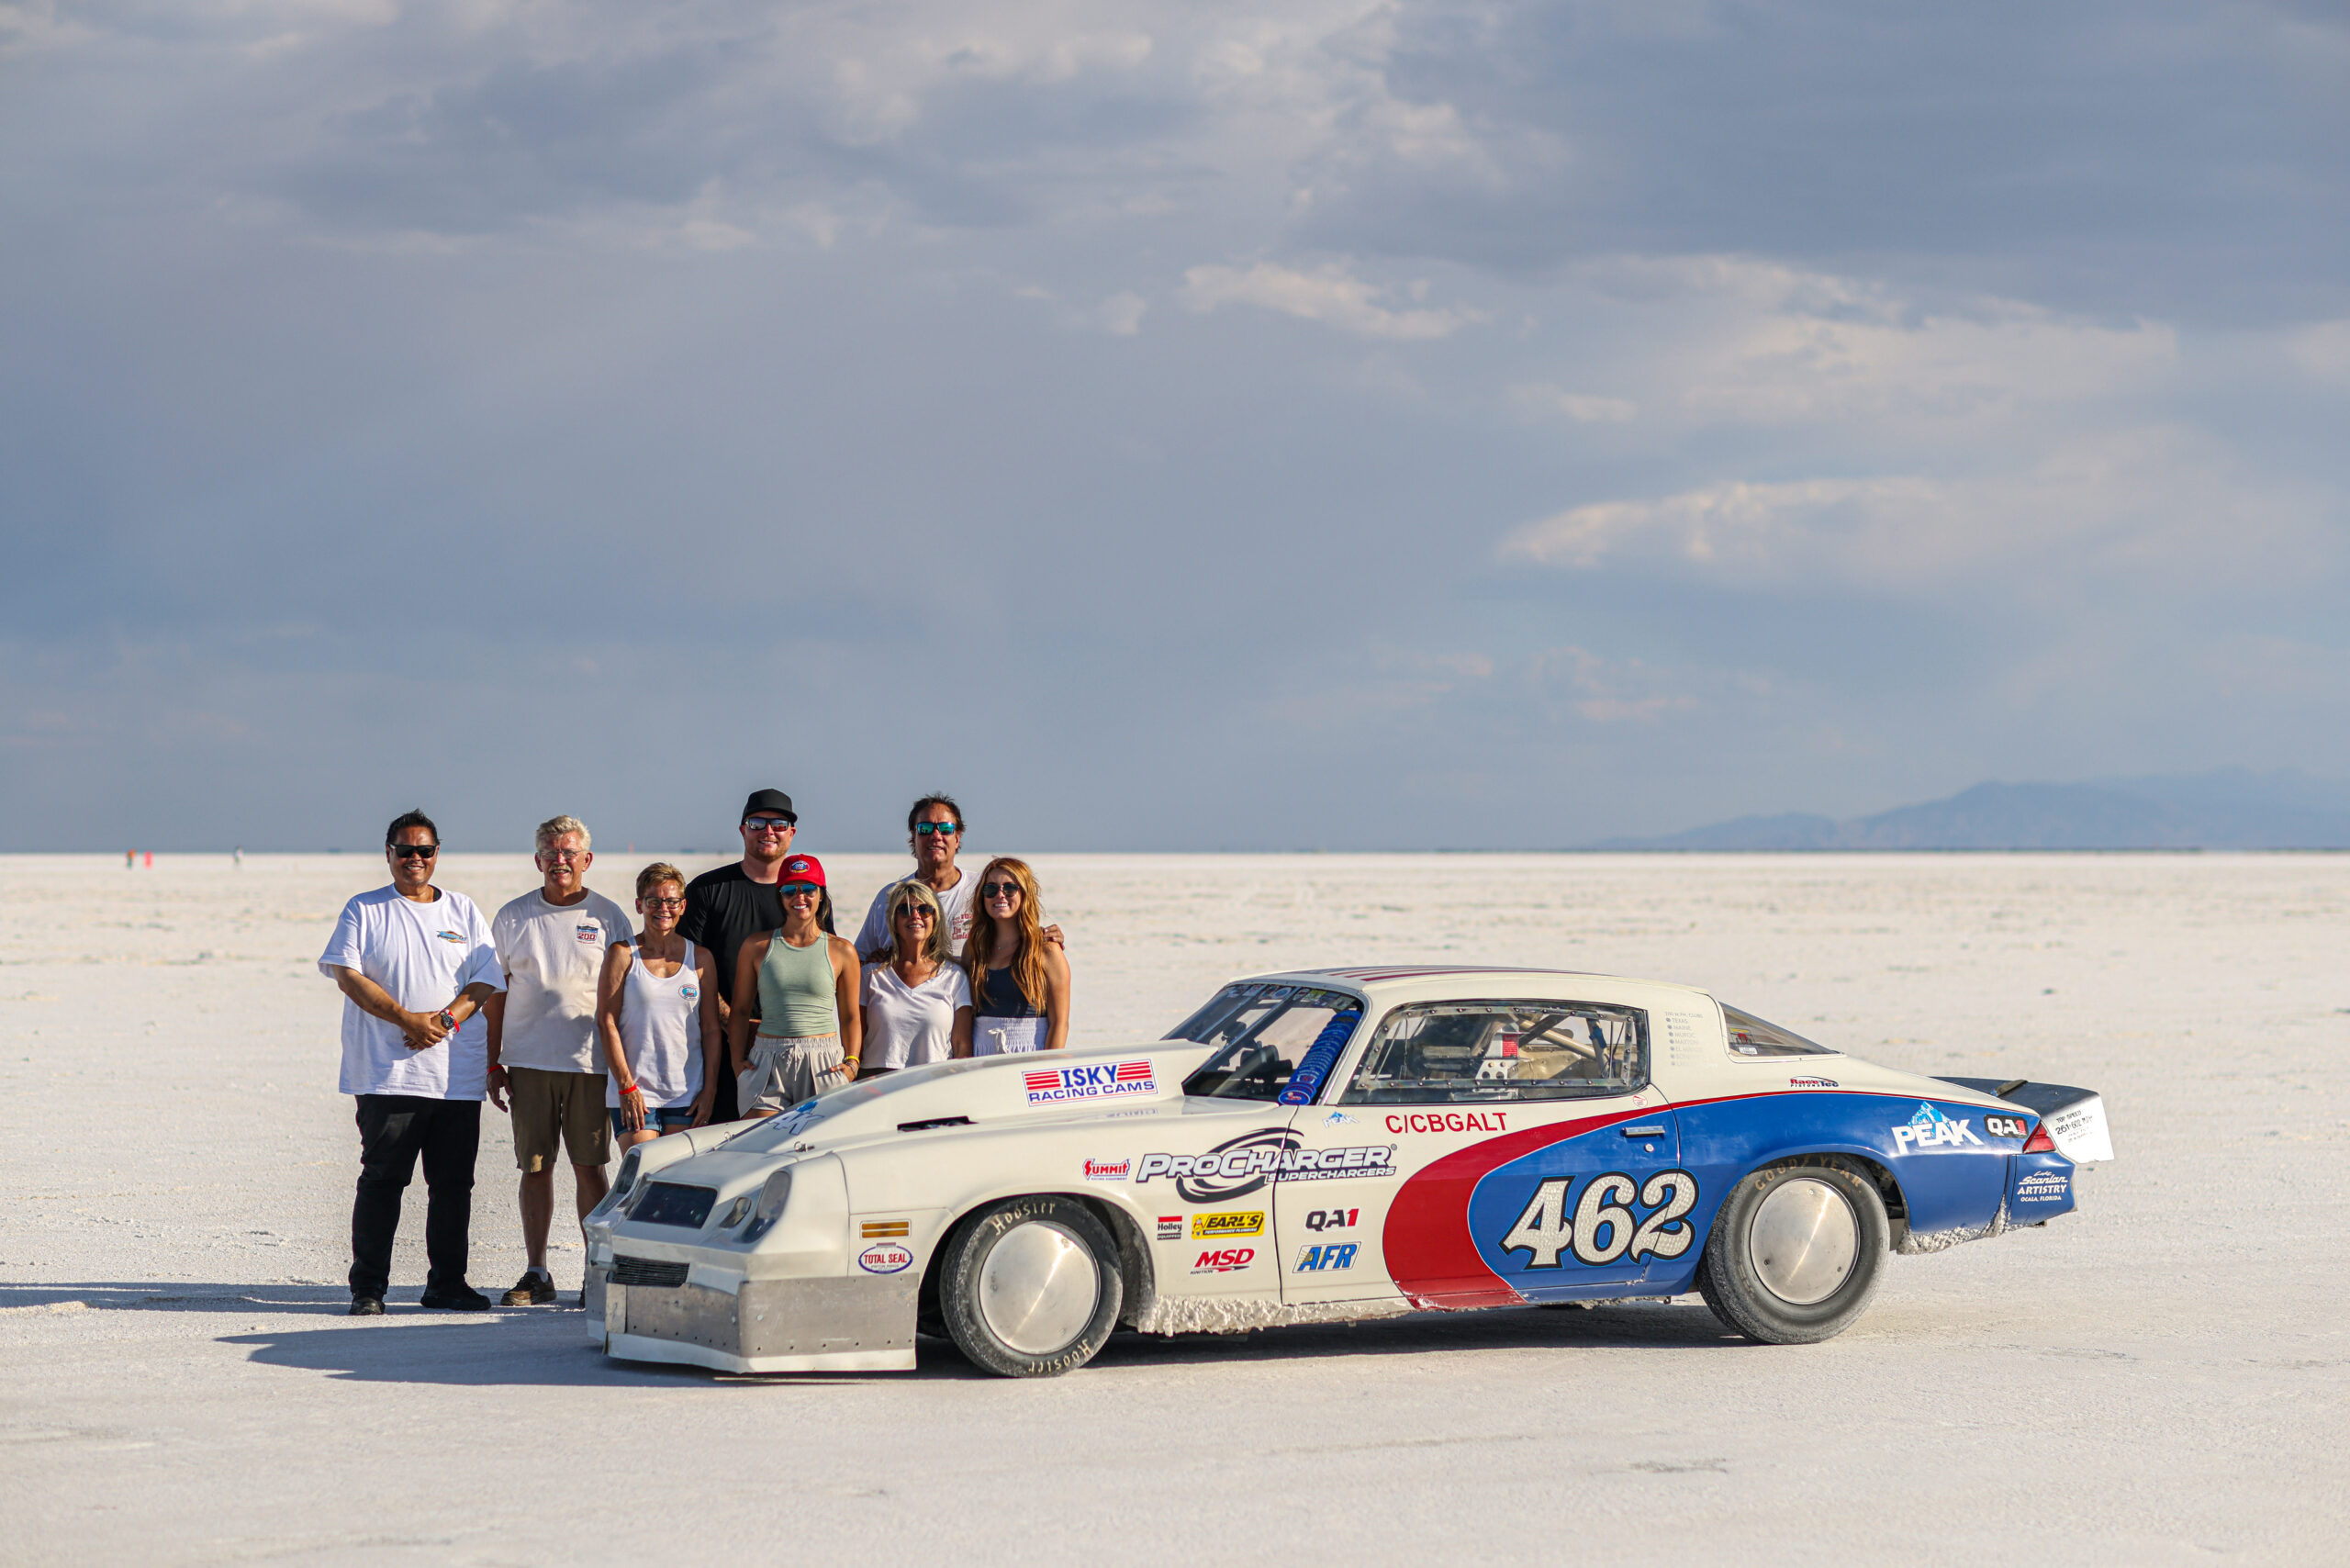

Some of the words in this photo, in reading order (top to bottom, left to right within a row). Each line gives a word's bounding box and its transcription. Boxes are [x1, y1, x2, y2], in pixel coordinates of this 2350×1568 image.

[577, 933, 596, 941] 200
[1061, 1065, 1117, 1088] ISKY
[1029, 1087, 1098, 1102] RACING
[1102, 1081, 1154, 1094] CAMS
[1322, 1114, 1360, 1128] PEAK
[1385, 1113, 1506, 1134] C/CBGALT
[2056, 1115, 2065, 1124] TOP
[2066, 1110, 2082, 1119] SPEED
[1986, 1117, 2027, 1137] QA1
[1891, 1119, 1985, 1155] PEAK
[1266, 1166, 1396, 1182] SUPERCHARGERS
[2019, 1174, 2068, 1185] Scanlan
[2017, 1184, 2067, 1194] ARTISTRY
[1158, 1223, 1182, 1232] Holley
[1206, 1215, 1259, 1228] EARL'S
[1305, 1208, 1359, 1232] QA1
[1498, 1169, 1700, 1271] 462
[864, 1254, 886, 1264] TOTAL
[889, 1253, 907, 1263] SEAL
[1194, 1249, 1255, 1268] MSD
[1297, 1244, 1357, 1271] AFR
